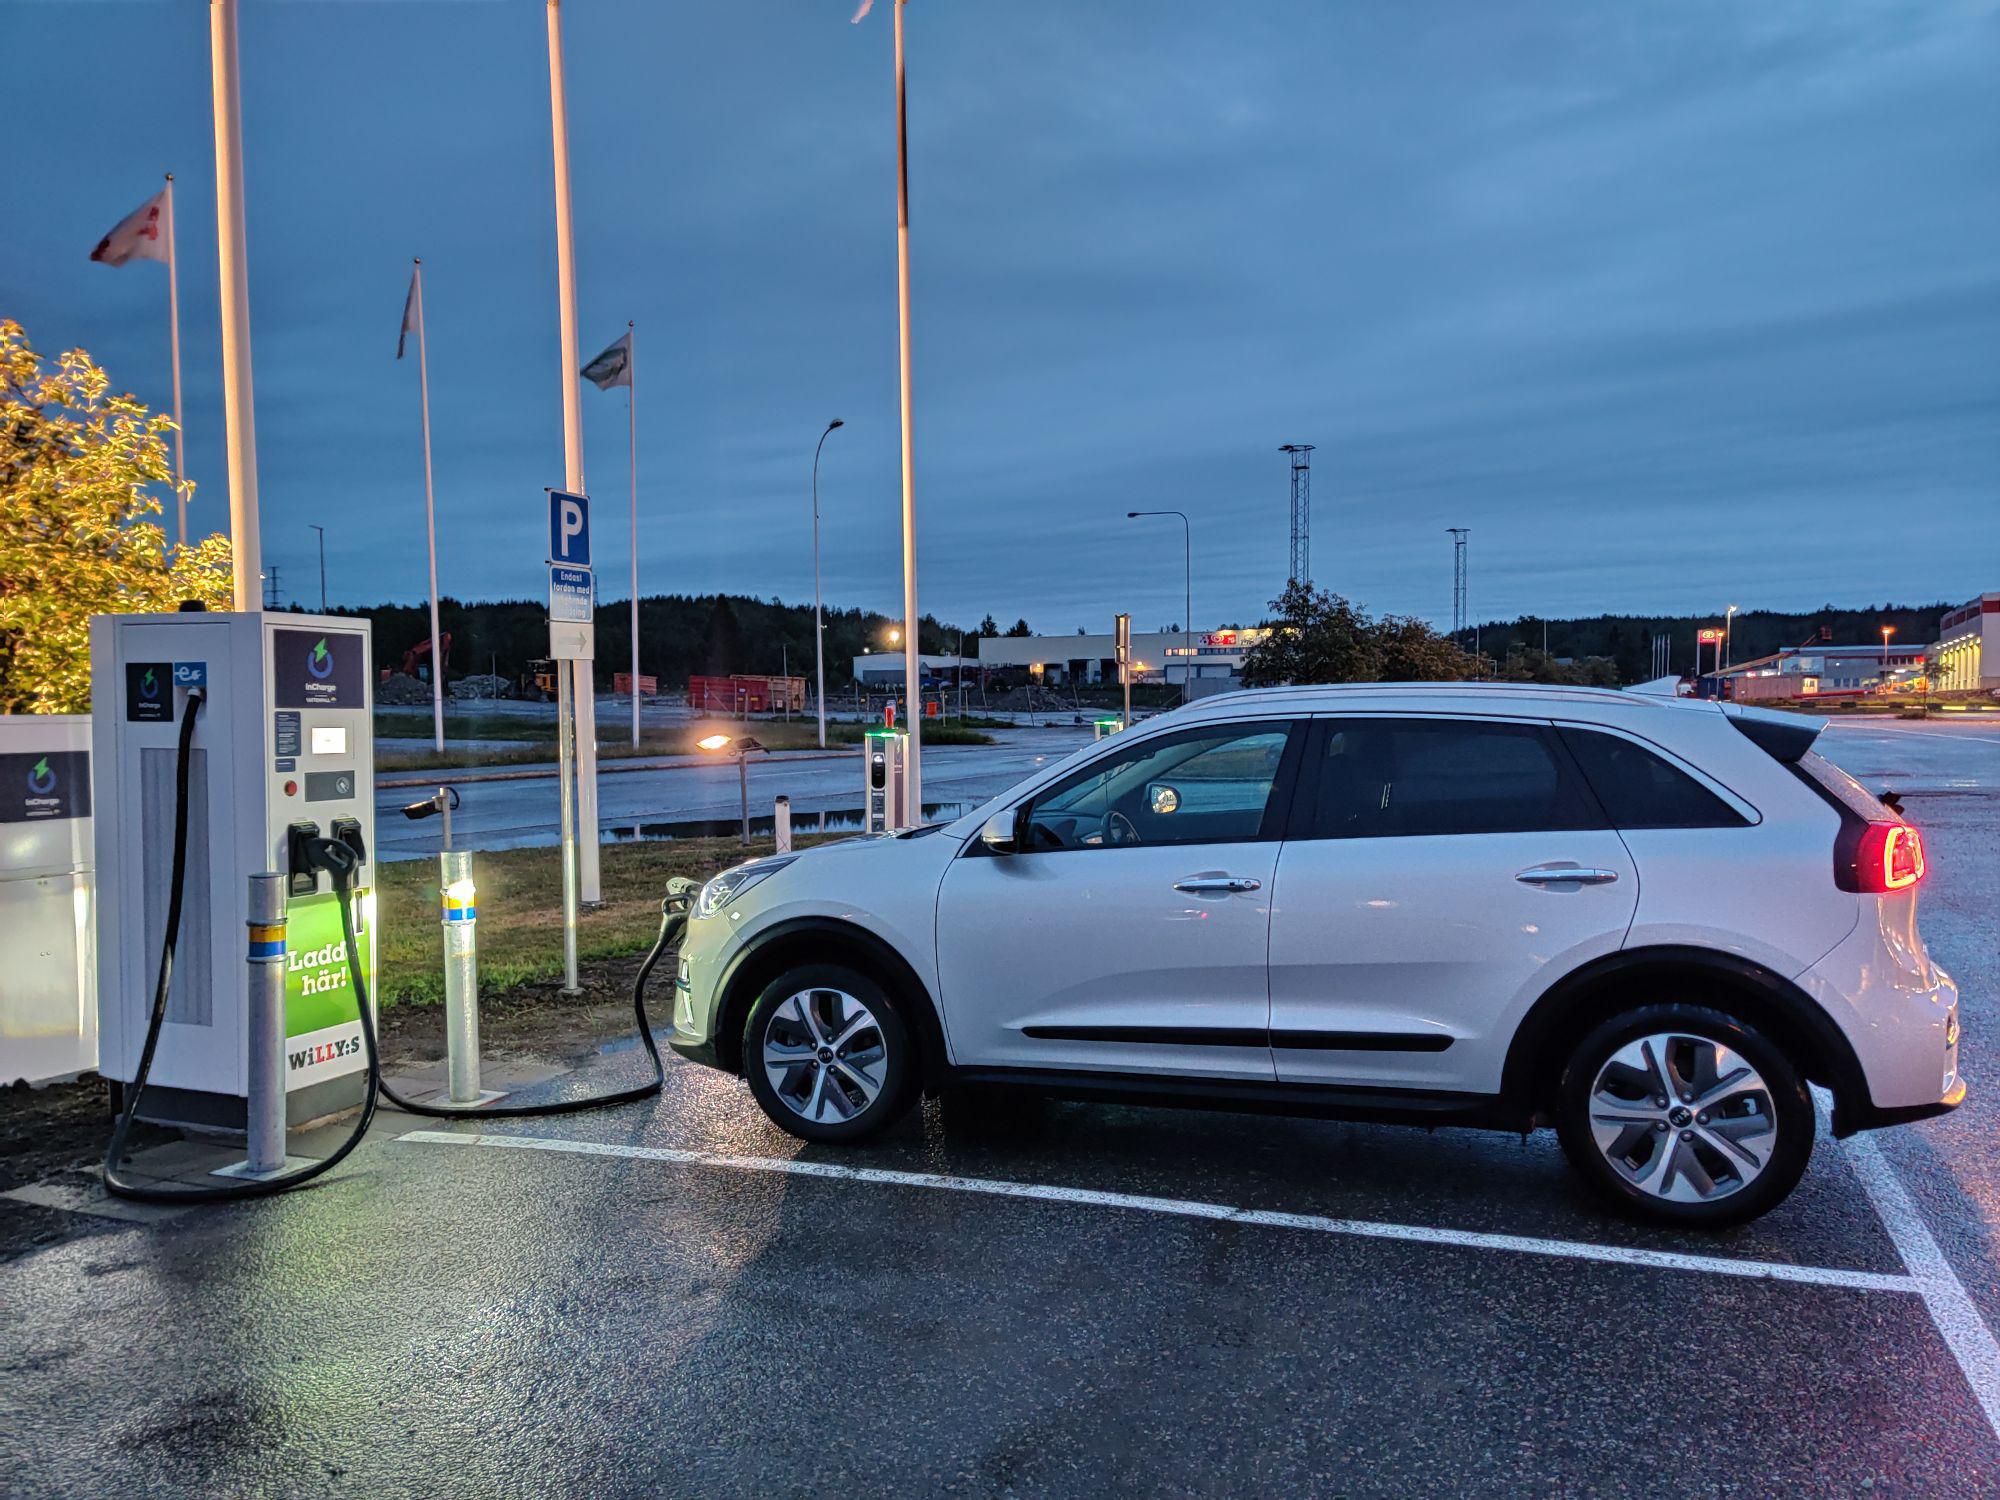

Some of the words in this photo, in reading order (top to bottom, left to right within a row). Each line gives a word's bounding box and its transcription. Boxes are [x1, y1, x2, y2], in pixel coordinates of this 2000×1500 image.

[560, 499, 583, 557] P
[560, 570, 582, 583] Endast
[553, 582, 575, 594] fordon
[576, 584, 590, 595] med
[305, 683, 336, 692] InCharge
[288, 940, 359, 972] Ladd
[302, 966, 347, 996] här!
